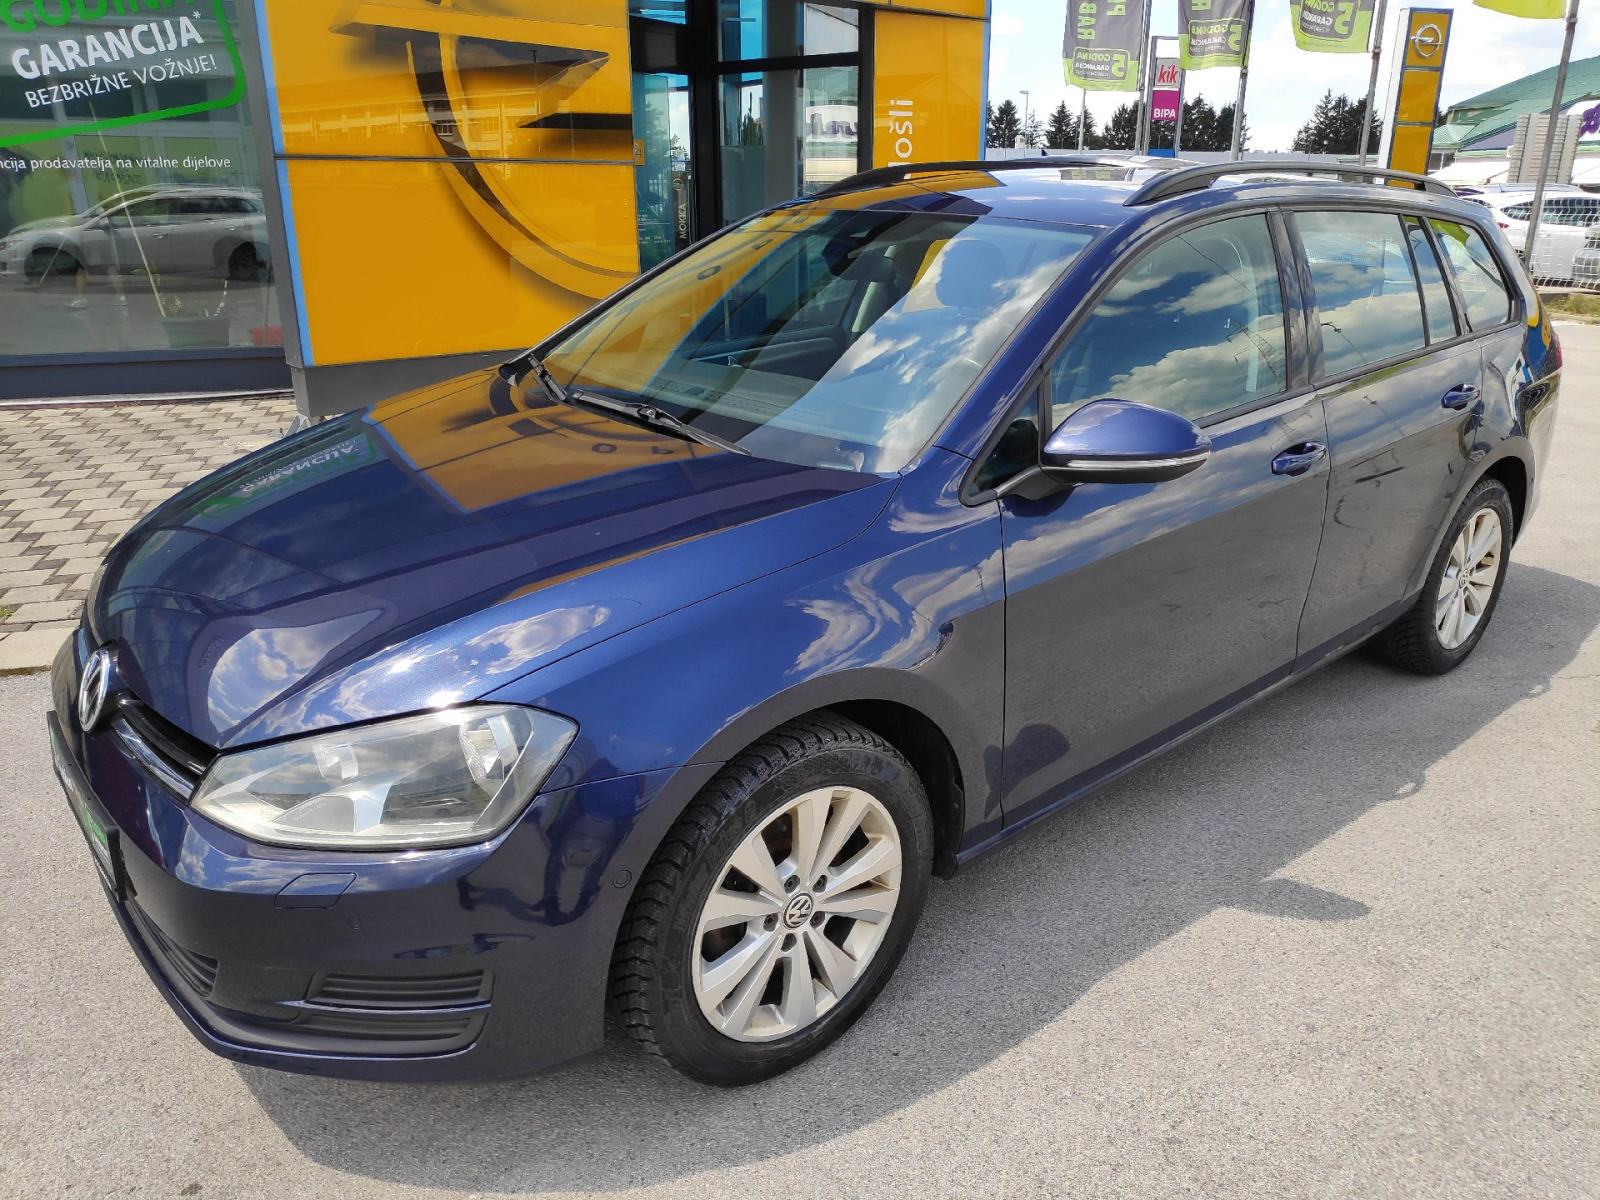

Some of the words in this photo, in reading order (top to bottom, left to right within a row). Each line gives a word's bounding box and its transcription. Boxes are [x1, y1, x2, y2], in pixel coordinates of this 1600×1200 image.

[25, 71, 131, 108] BEZBRIŽNE
[134, 53, 218, 84] VOŽNJE!
[1158, 64, 1178, 83] kik
[1154, 108, 1176, 118] BIPA
[887, 99, 913, 178] ošli
[31, 156, 112, 172] prodavatelja
[116, 159, 132, 168] na
[136, 155, 179, 169] vitalne
[182, 155, 231, 171] dijelove
[678, 203, 687, 239] MOKKA
